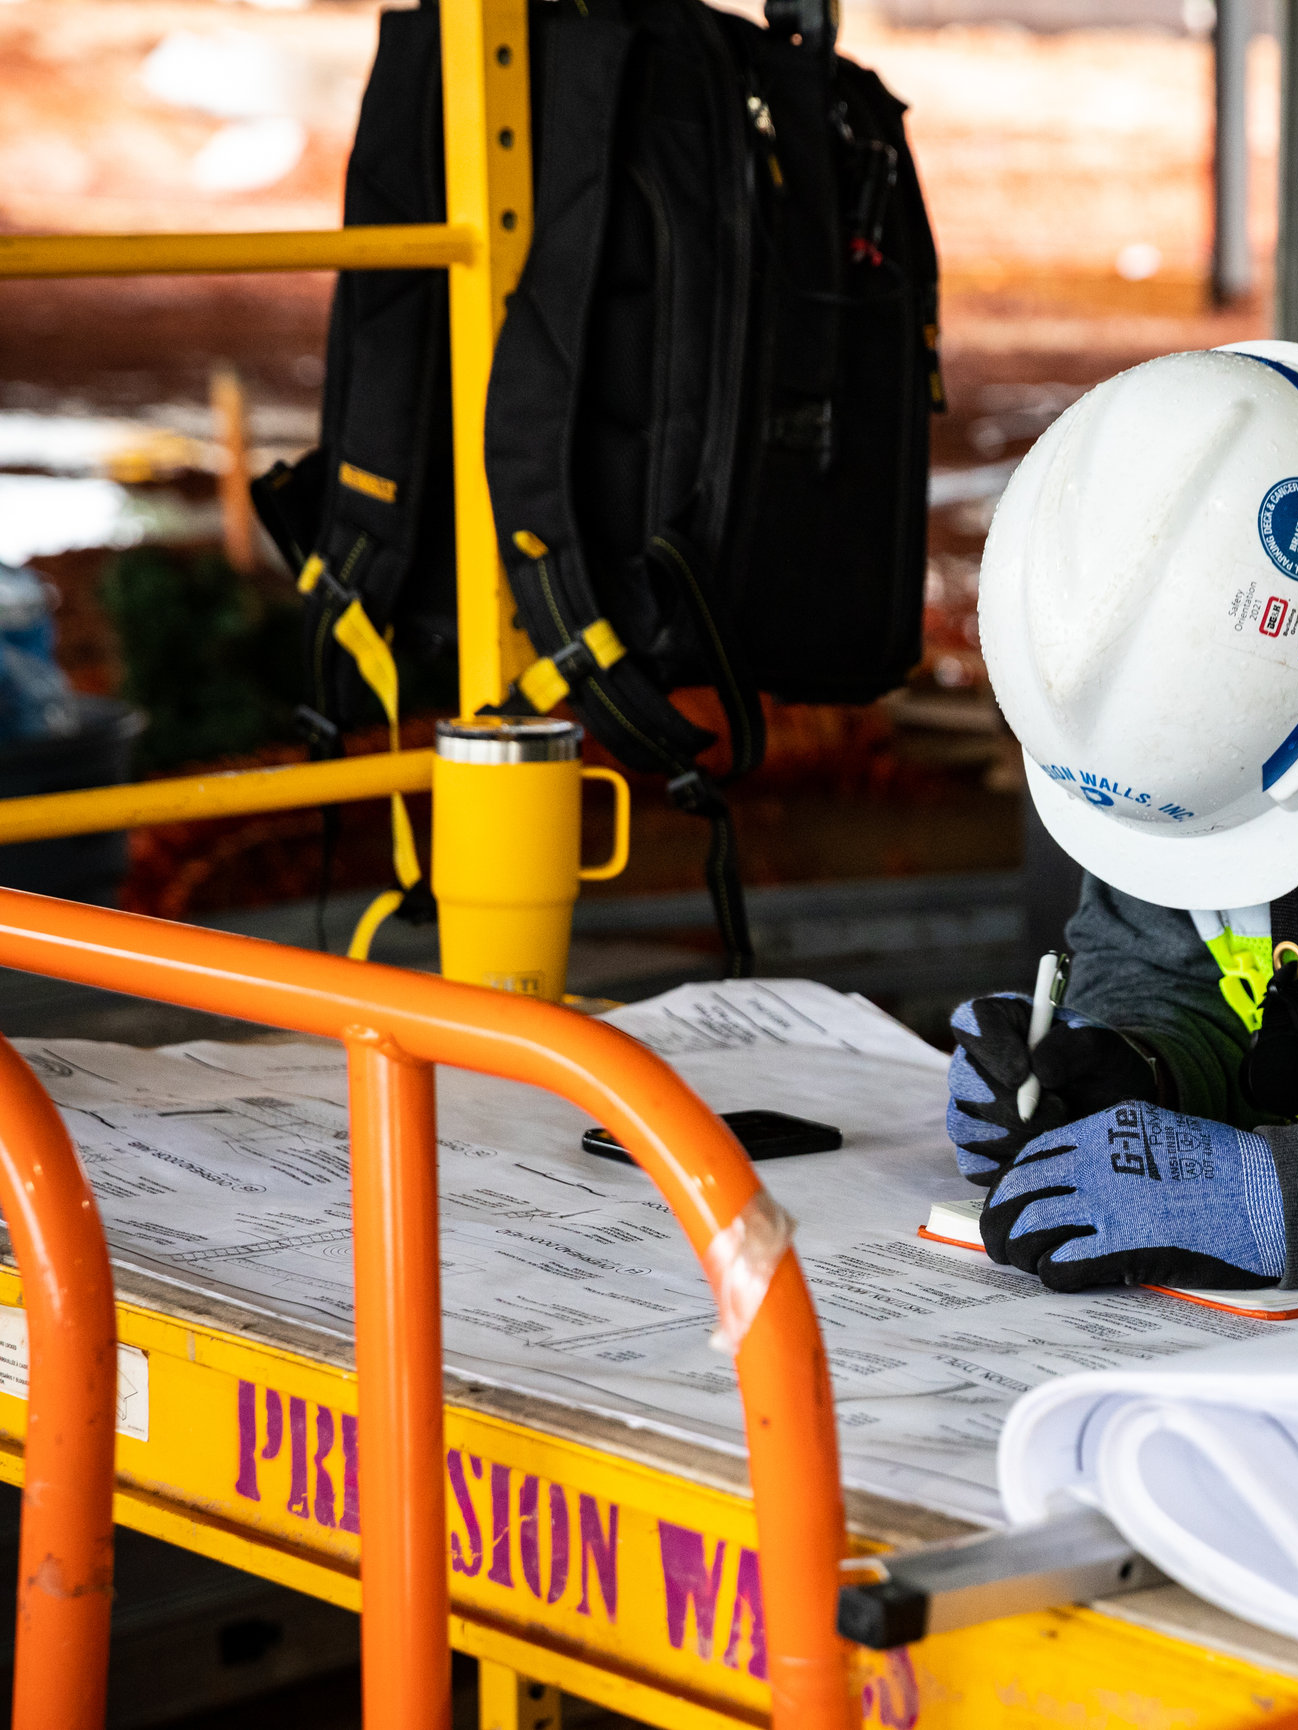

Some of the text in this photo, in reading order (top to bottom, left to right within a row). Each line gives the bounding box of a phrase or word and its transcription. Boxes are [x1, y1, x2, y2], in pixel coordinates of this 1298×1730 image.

[1270, 482, 1298, 504] CANCER
[1263, 510, 1273, 535] DECK
[1266, 534, 1294, 570] PARKING
[1228, 589, 1245, 617] Safety
[1235, 581, 1257, 632] Orientation
[1249, 599, 1263, 621] 2021
[1108, 1106, 1145, 1177] G-Te
[1169, 1156, 1180, 1181] ANSI
[1184, 1162, 1197, 1175] A5
[1202, 1159, 1214, 1179] CUT
[235, 1379, 619, 1625] PRSION
